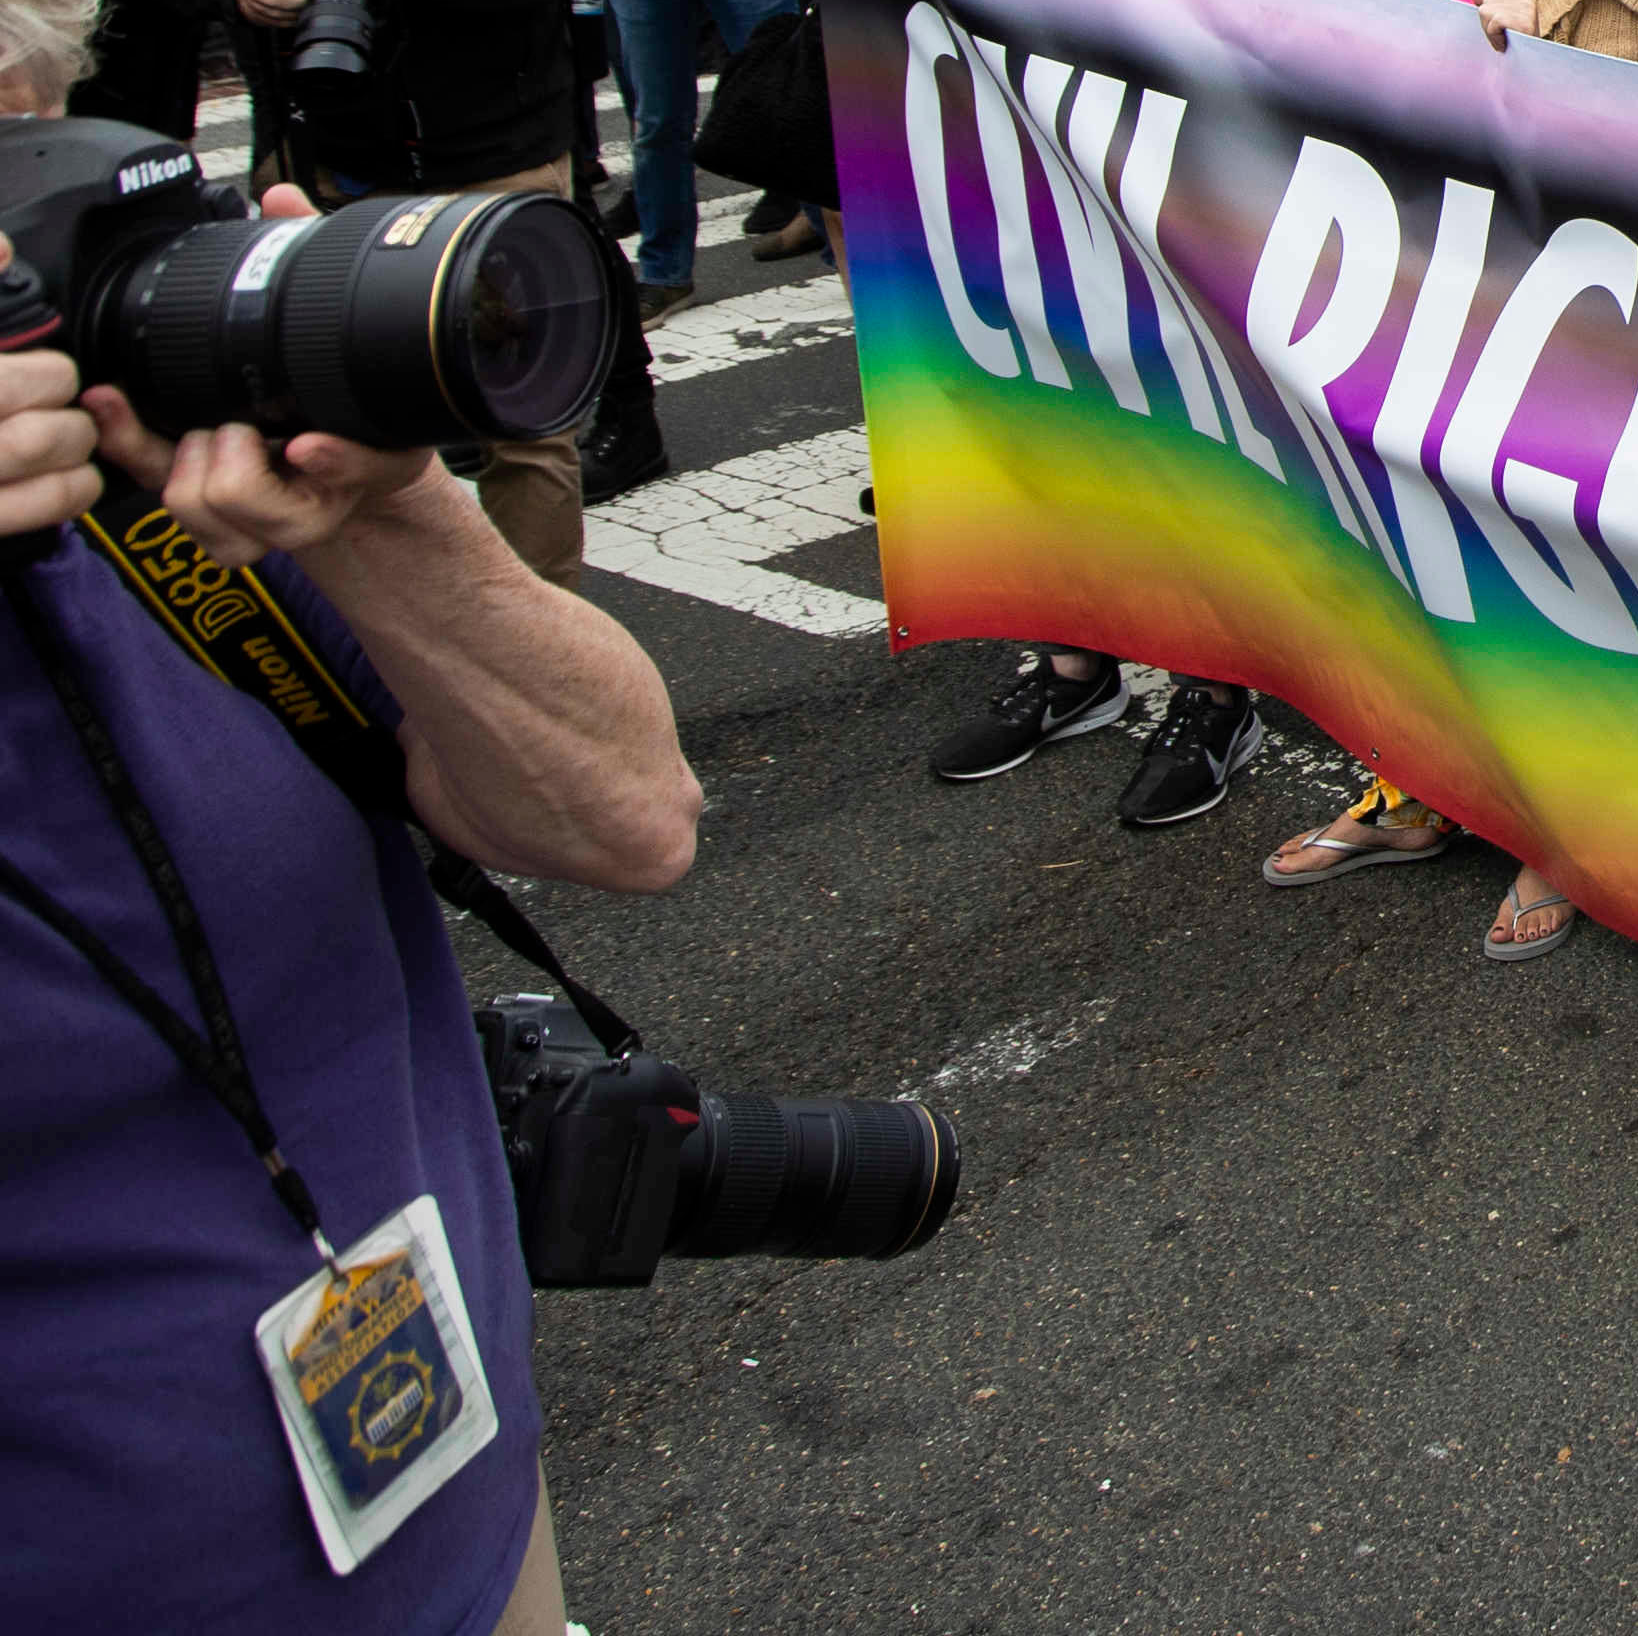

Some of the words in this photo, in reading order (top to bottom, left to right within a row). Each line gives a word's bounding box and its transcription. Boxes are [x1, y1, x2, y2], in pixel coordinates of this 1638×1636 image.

[119, 152, 193, 194] Nikon
[904, 1, 1289, 485] CIVIL
[124, 508, 260, 642] D850
[242, 635, 329, 726] Nikon
